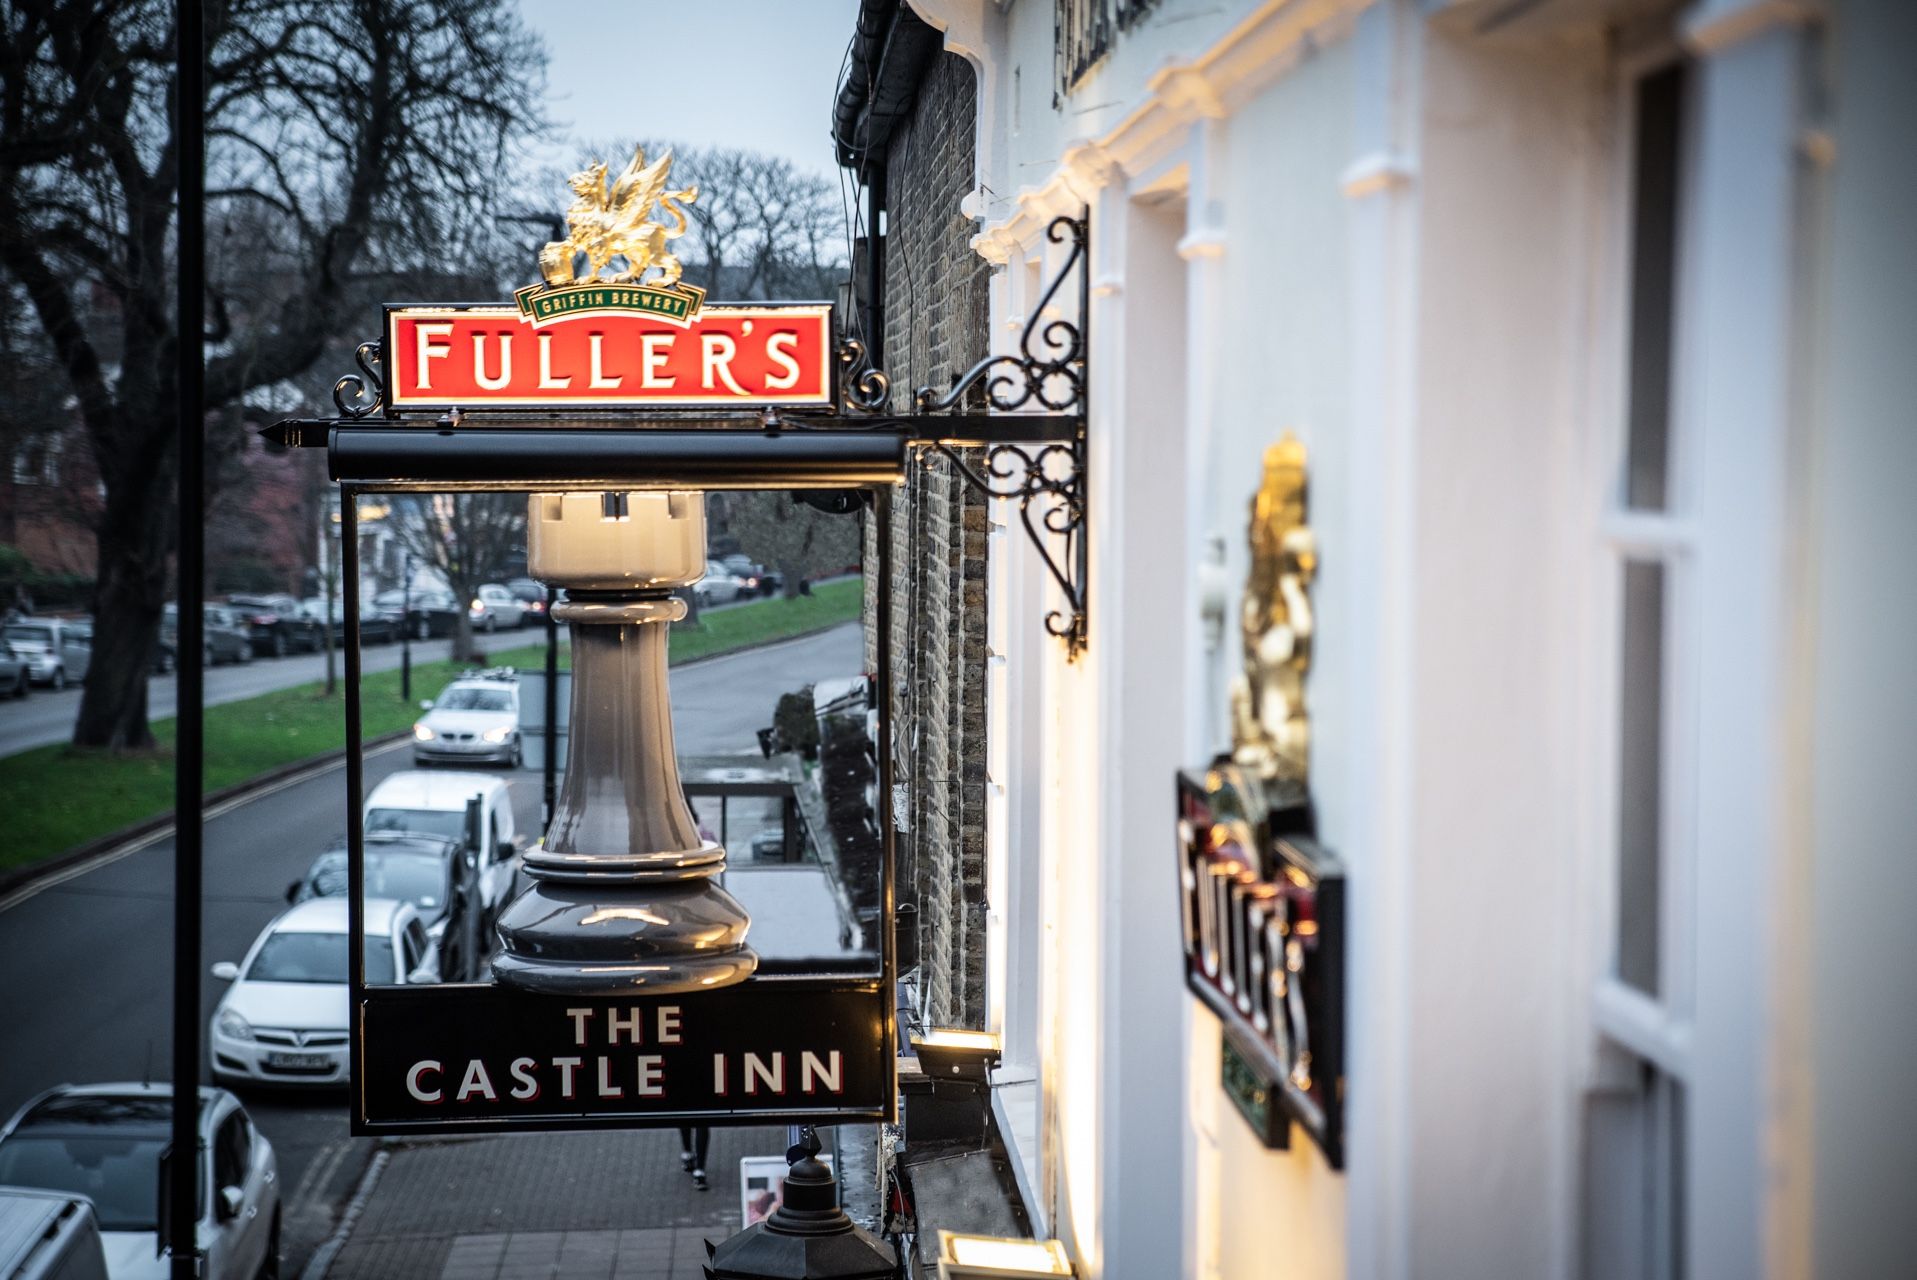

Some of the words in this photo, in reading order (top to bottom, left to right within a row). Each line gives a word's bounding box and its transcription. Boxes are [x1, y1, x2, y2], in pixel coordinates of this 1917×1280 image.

[541, 293, 603, 313] GRIFFIN
[611, 292, 682, 313] BREWERY
[415, 320, 801, 396] FULLER'S
[567, 1006, 683, 1046] THE
[406, 1055, 667, 1103] CASTLE
[714, 1050, 844, 1095] INN
